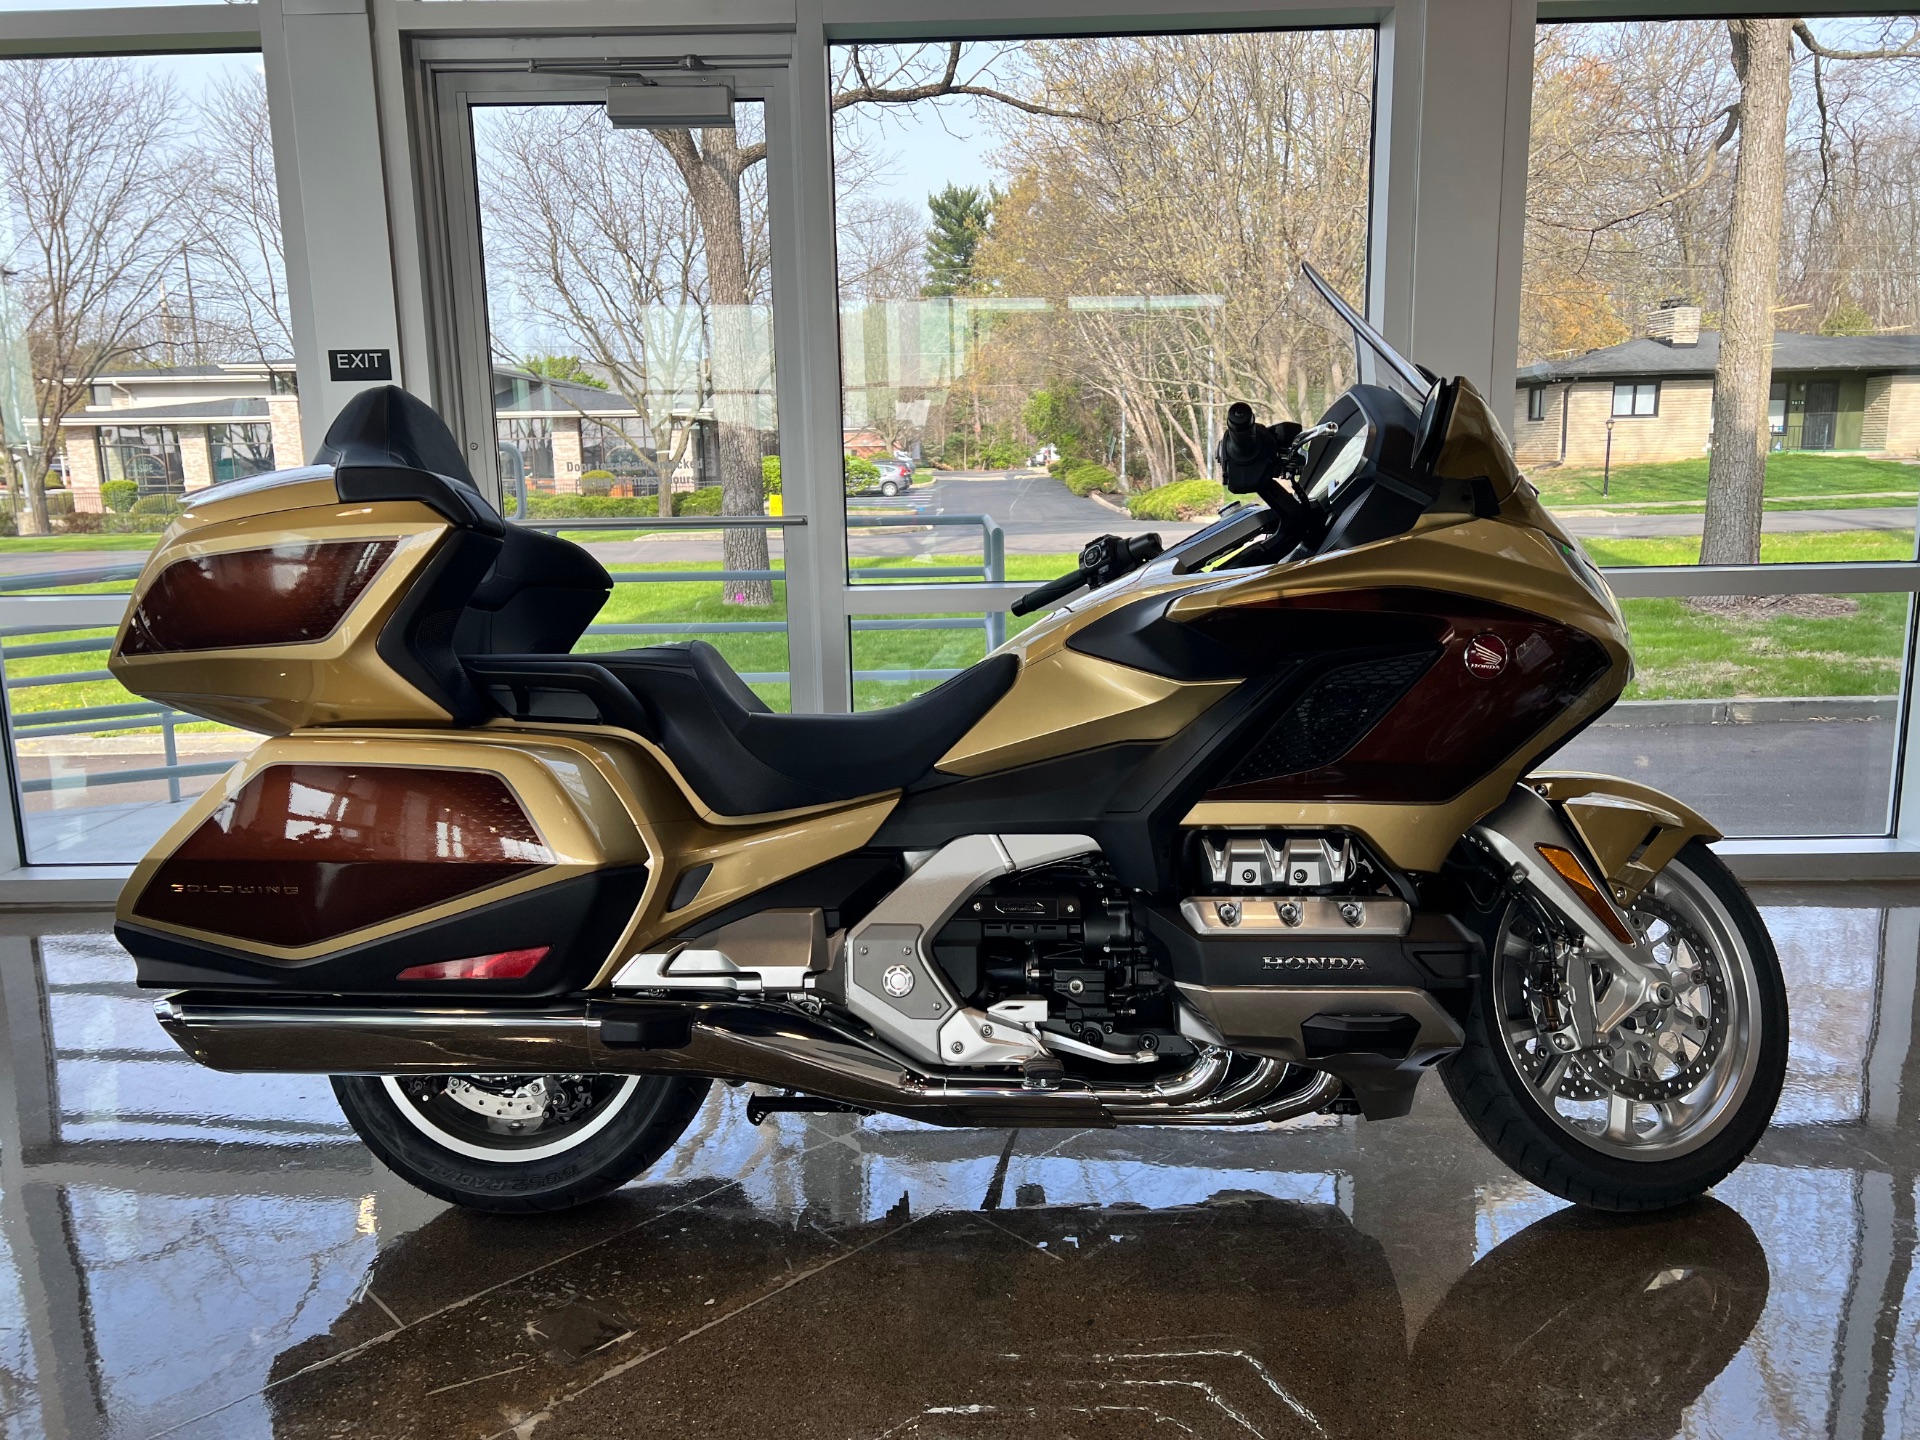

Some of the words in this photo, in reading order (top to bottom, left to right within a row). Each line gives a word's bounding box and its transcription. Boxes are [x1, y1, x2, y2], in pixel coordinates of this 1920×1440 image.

[336, 353, 382, 368] EXIT
[566, 461, 592, 472] Door
[595, 460, 606, 471] to
[655, 458, 703, 469] ncked
[1262, 955, 1369, 970] HONDA
[427, 1162, 505, 1190] RADIAL
